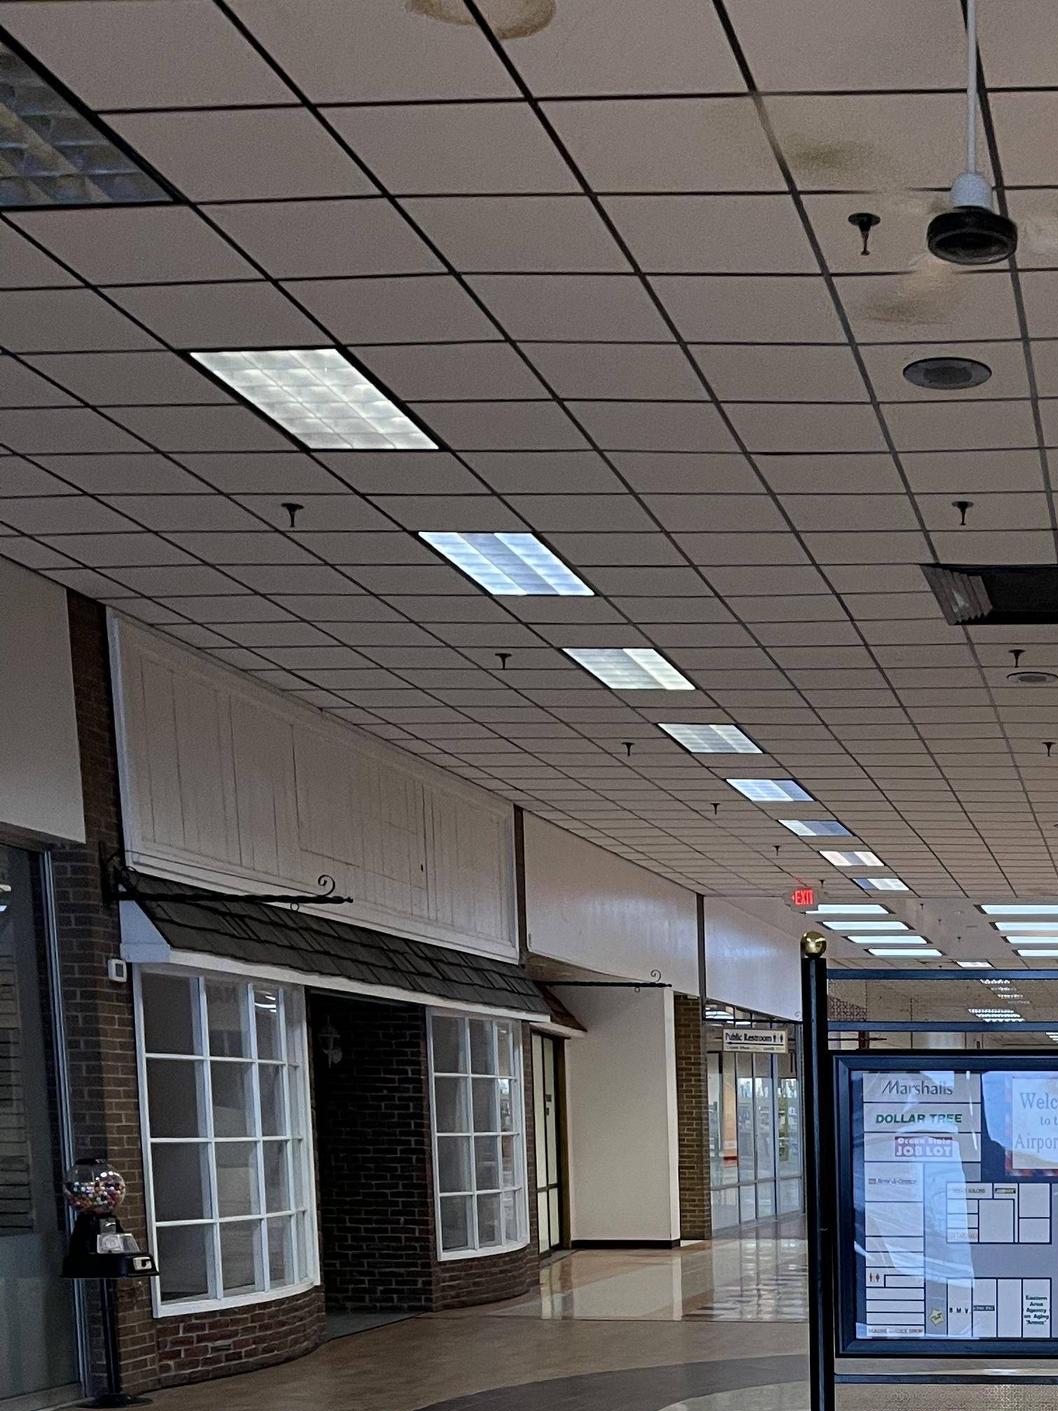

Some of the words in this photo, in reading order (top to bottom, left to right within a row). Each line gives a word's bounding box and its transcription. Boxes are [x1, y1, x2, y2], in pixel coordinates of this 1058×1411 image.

[795, 889, 813, 905] EXIT
[725, 1032, 743, 1041] Public
[881, 1079, 953, 1096] Marshalls
[875, 1113, 926, 1124] DOLLAR
[929, 1113, 963, 1123] TREE
[1040, 1116, 1051, 1126] to
[895, 1145, 924, 1156] JOB
[926, 1145, 952, 1156] LOT
